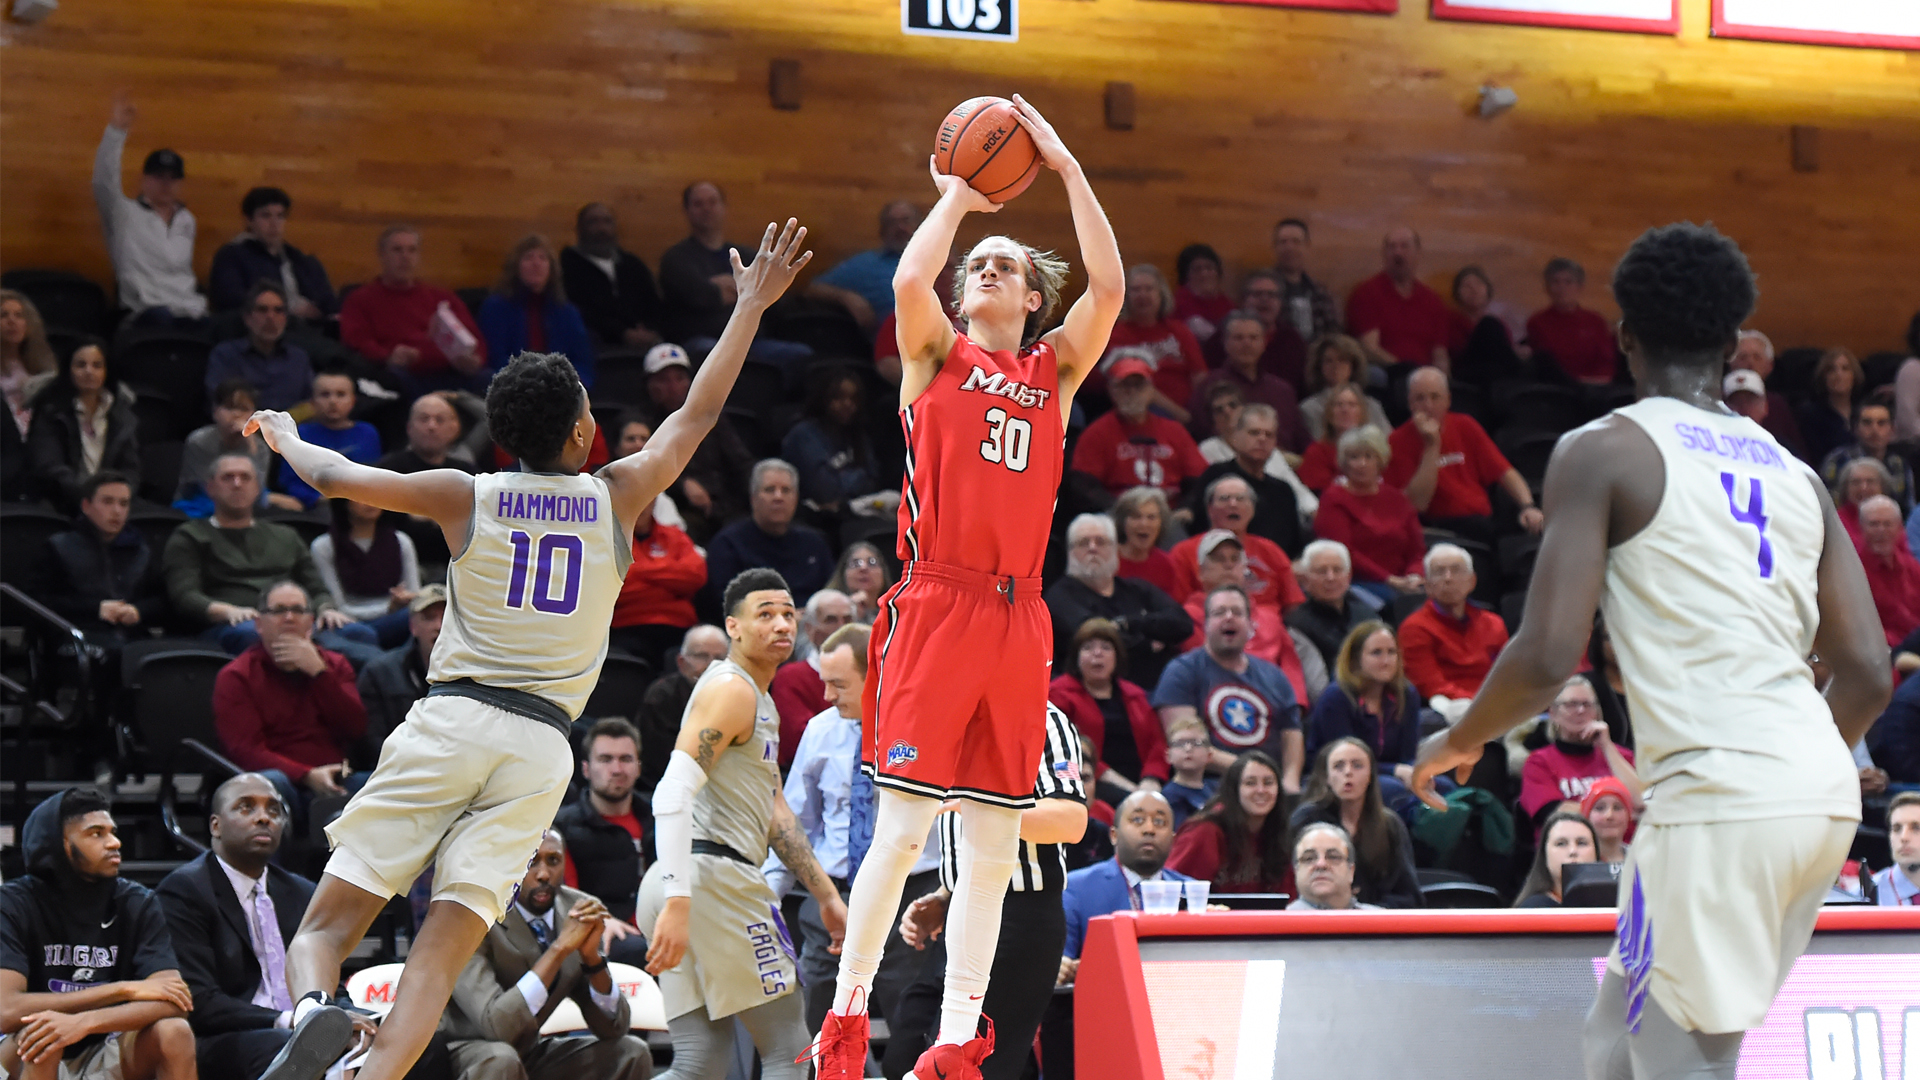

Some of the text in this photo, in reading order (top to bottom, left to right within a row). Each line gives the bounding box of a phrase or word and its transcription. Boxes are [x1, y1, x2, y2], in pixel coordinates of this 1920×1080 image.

[940, 122, 958, 153] THE
[982, 127, 1007, 153] ROCK
[980, 406, 1032, 473] 30
[1675, 423, 1787, 471] SOLOMON
[497, 491, 598, 523] HAMMOND
[1720, 471, 1773, 579] 4
[504, 529, 585, 617] 10
[887, 746, 917, 766] MAAC
[747, 922, 786, 996] EAGLES
